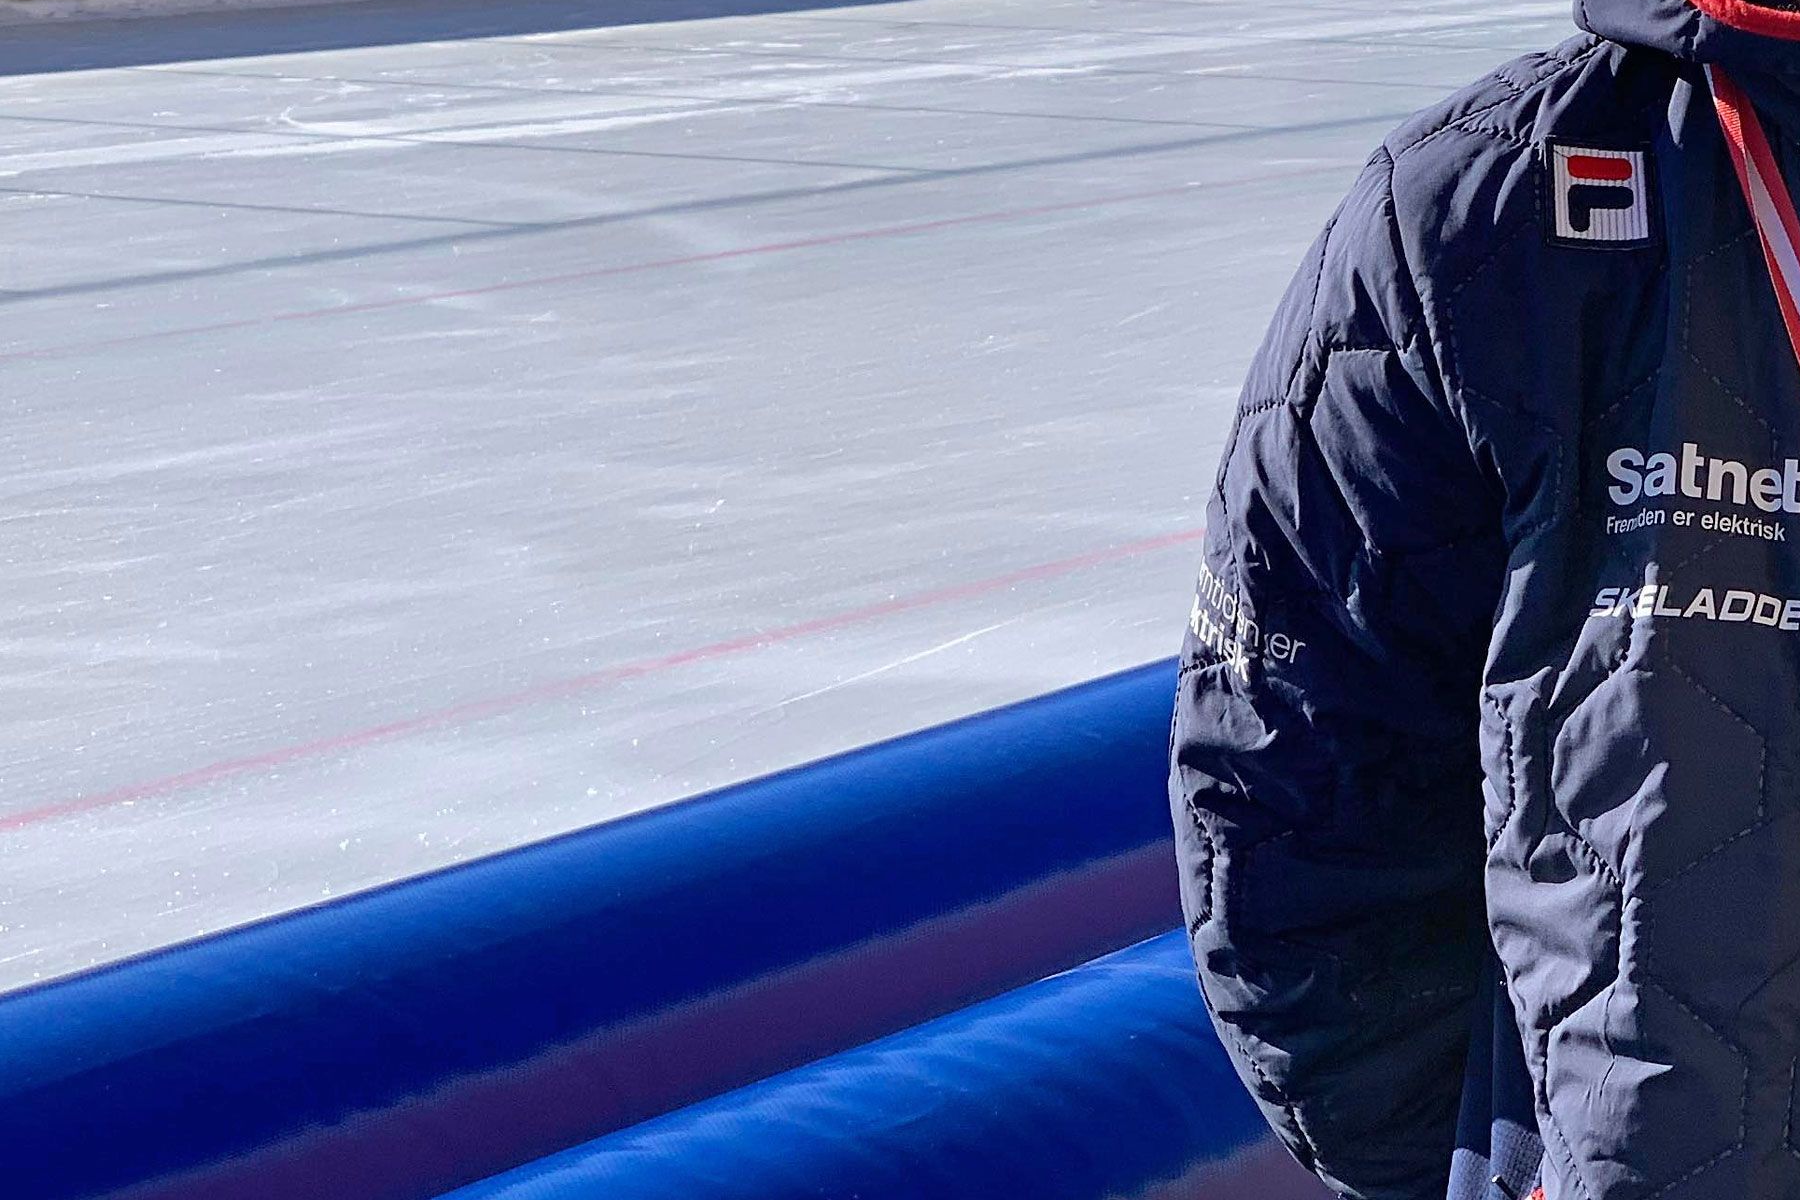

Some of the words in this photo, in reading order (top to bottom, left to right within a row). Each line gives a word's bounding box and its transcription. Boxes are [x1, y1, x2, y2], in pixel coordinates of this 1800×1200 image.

[1672, 510, 1696, 527] er
[1701, 511, 1786, 542] elektrisk
[1189, 593, 1250, 684] ktrisk
[1270, 632, 1306, 664] er
